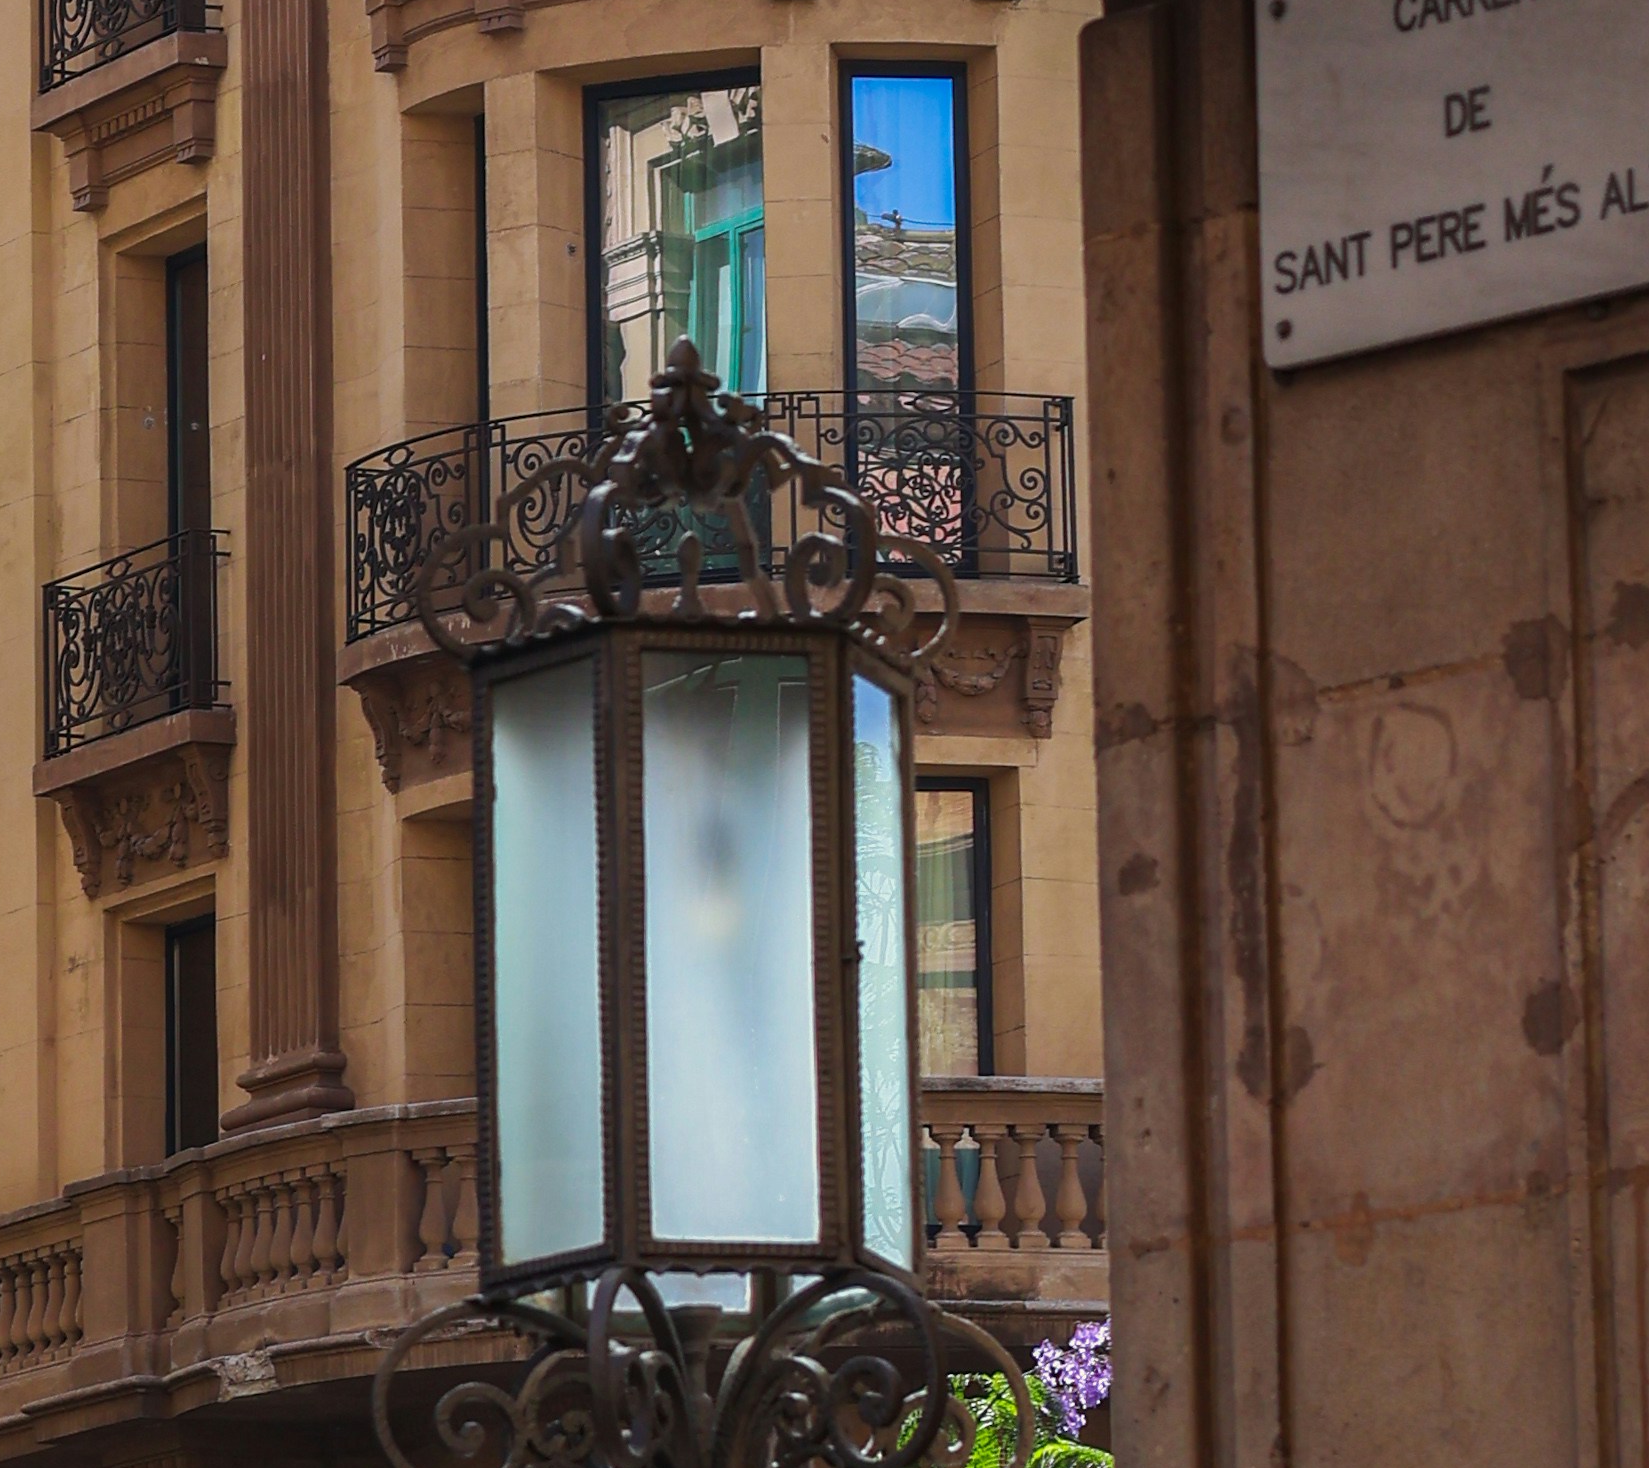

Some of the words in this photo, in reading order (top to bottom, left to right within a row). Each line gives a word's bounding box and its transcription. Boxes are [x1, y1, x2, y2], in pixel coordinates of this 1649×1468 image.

[1444, 85, 1492, 139] DE
[1274, 231, 1372, 295] SANT
[1390, 203, 1486, 269] PERE
[1504, 164, 1581, 242] MÉS
